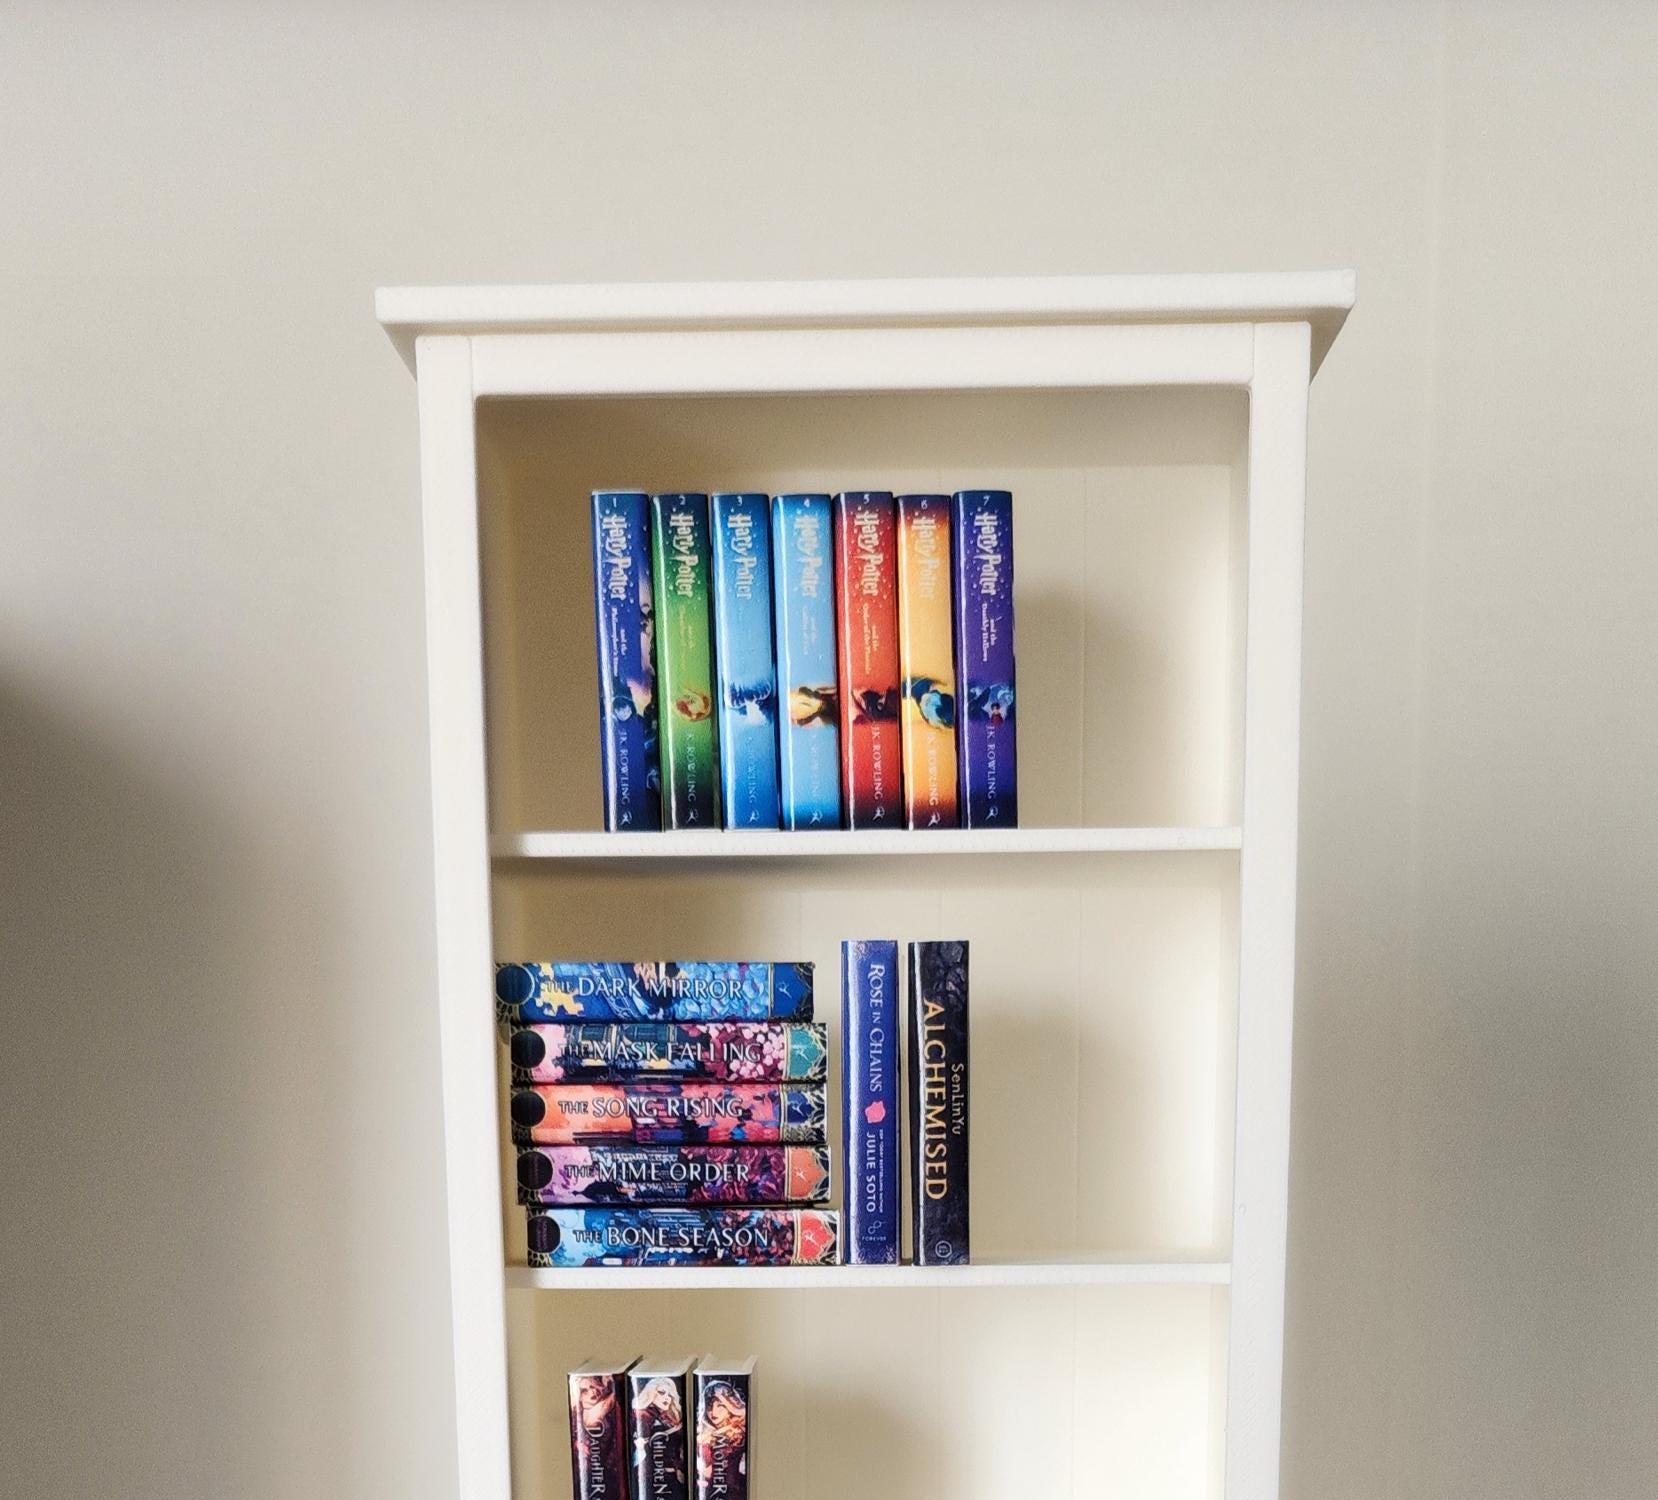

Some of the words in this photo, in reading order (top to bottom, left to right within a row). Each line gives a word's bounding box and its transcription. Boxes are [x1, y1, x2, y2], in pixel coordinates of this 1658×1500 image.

[612, 498, 618, 508] 1
[679, 495, 686, 505] 2
[863, 494, 870, 504] 5
[983, 495, 990, 506] 7
[602, 516, 627, 557] Harry
[670, 513, 698, 554] Harry
[728, 514, 753, 556] Harry
[795, 514, 820, 556] Harry
[855, 511, 880, 553] Harry
[912, 517, 938, 558] Harry
[974, 512, 999, 553] Harry
[604, 557, 632, 600] Potter
[672, 555, 699, 598] Potter
[736, 556, 757, 600] Potter
[799, 556, 823, 598] Potter
[855, 554, 884, 596] Potter
[973, 554, 1002, 596] Potter
[619, 748, 630, 805] ROWLING
[686, 746, 697, 802] ROWLING
[872, 744, 883, 800] ROWLING
[927, 749, 939, 807] ROWLING
[987, 744, 997, 800] ROWLING
[578, 977, 641, 998] DARK
[649, 979, 744, 1000] MIRROR
[869, 964, 885, 1007] ROSE
[872, 1011, 881, 1023] IN
[558, 1043, 592, 1057] THE
[594, 1041, 663, 1061] MASK
[666, 1042, 762, 1062] FALLING
[869, 1027, 885, 1092] CHAINS
[558, 1101, 589, 1114] THE
[592, 1097, 658, 1118] SONG
[666, 1098, 743, 1118] RISING
[924, 997, 947, 1199] ALCHEMISED
[866, 1132, 876, 1169] JULIE
[565, 1165, 598, 1178] THE
[599, 1163, 663, 1182] MIME
[669, 1163, 749, 1182] ORDER
[866, 1175, 876, 1213] SOTO
[574, 1230, 601, 1243] THE
[607, 1227, 670, 1247] BONE
[678, 1227, 768, 1247] SEASON
[586, 1425, 606, 1497] DAUGHTER
[649, 1431, 672, 1495] CHILDREN
[710, 1435, 728, 1499] MOTHER
